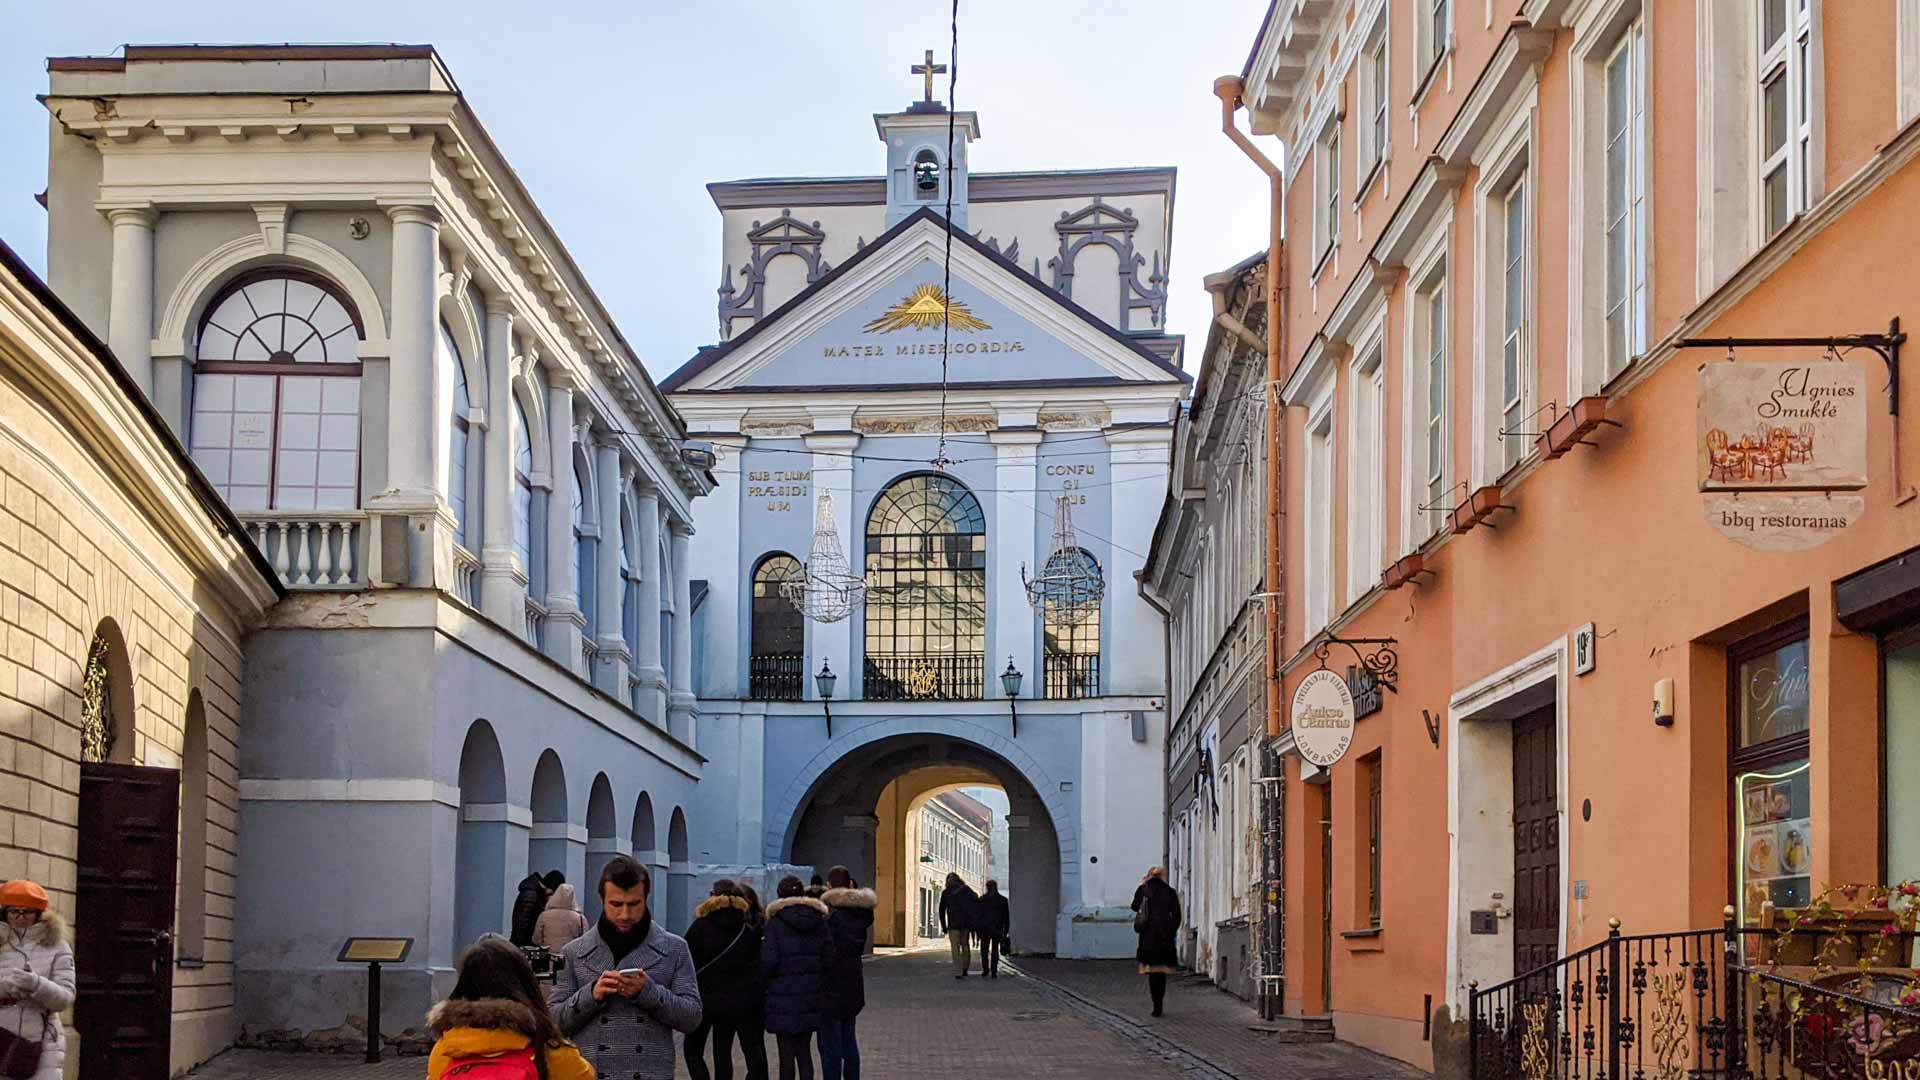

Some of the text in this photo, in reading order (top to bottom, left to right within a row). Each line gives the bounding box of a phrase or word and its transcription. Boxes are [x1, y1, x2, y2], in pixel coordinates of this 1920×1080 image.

[824, 346, 885, 358] MATER
[1779, 367, 1856, 402] Ugnies
[1757, 389, 1838, 419] Smuklė
[748, 470, 811, 481] SUB TUUM
[1046, 464, 1095, 476] CONFU
[1063, 479, 1079, 490] GI
[1721, 510, 1848, 532] bbq restoranas
[1297, 735, 1349, 763] LOMBARDAS
